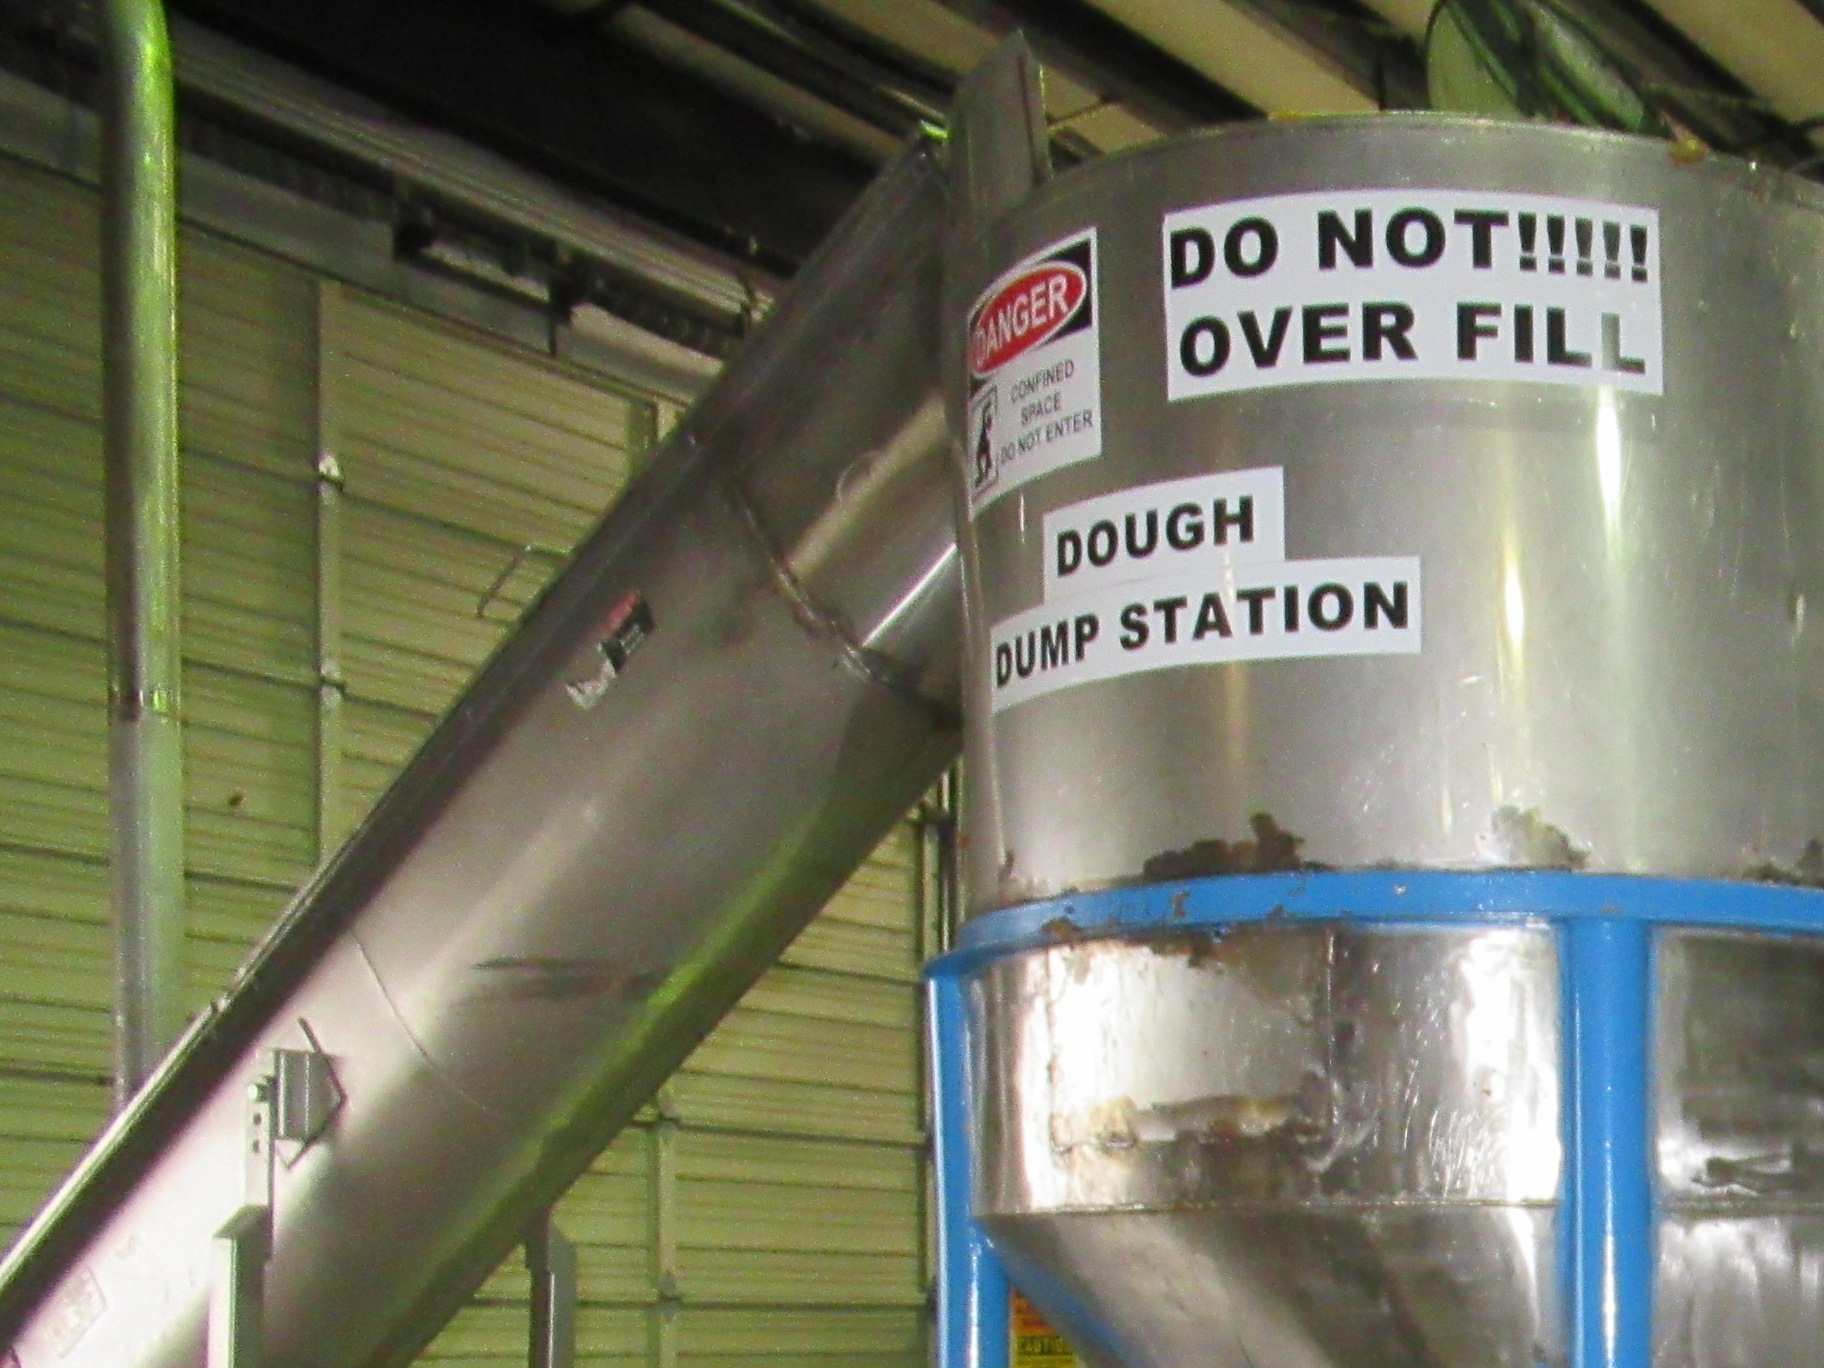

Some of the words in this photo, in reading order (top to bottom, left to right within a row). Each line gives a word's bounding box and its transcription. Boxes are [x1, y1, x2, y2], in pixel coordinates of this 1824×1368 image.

[1170, 214, 1279, 290] DO
[1317, 206, 1648, 283] NOT!!!!!
[975, 272, 1070, 367] DANGER
[1179, 300, 1419, 378] OVER
[1456, 301, 1646, 374] FILL
[1009, 358, 1075, 403] CONFINED
[1020, 390, 1063, 426] SPACE
[1000, 440, 1017, 467] DO
[1017, 425, 1043, 454] NOT
[1045, 408, 1094, 444] ENTER
[1056, 494, 1254, 577] DOUGH
[996, 612, 1099, 689] DUMP
[1119, 581, 1409, 651] STATION
